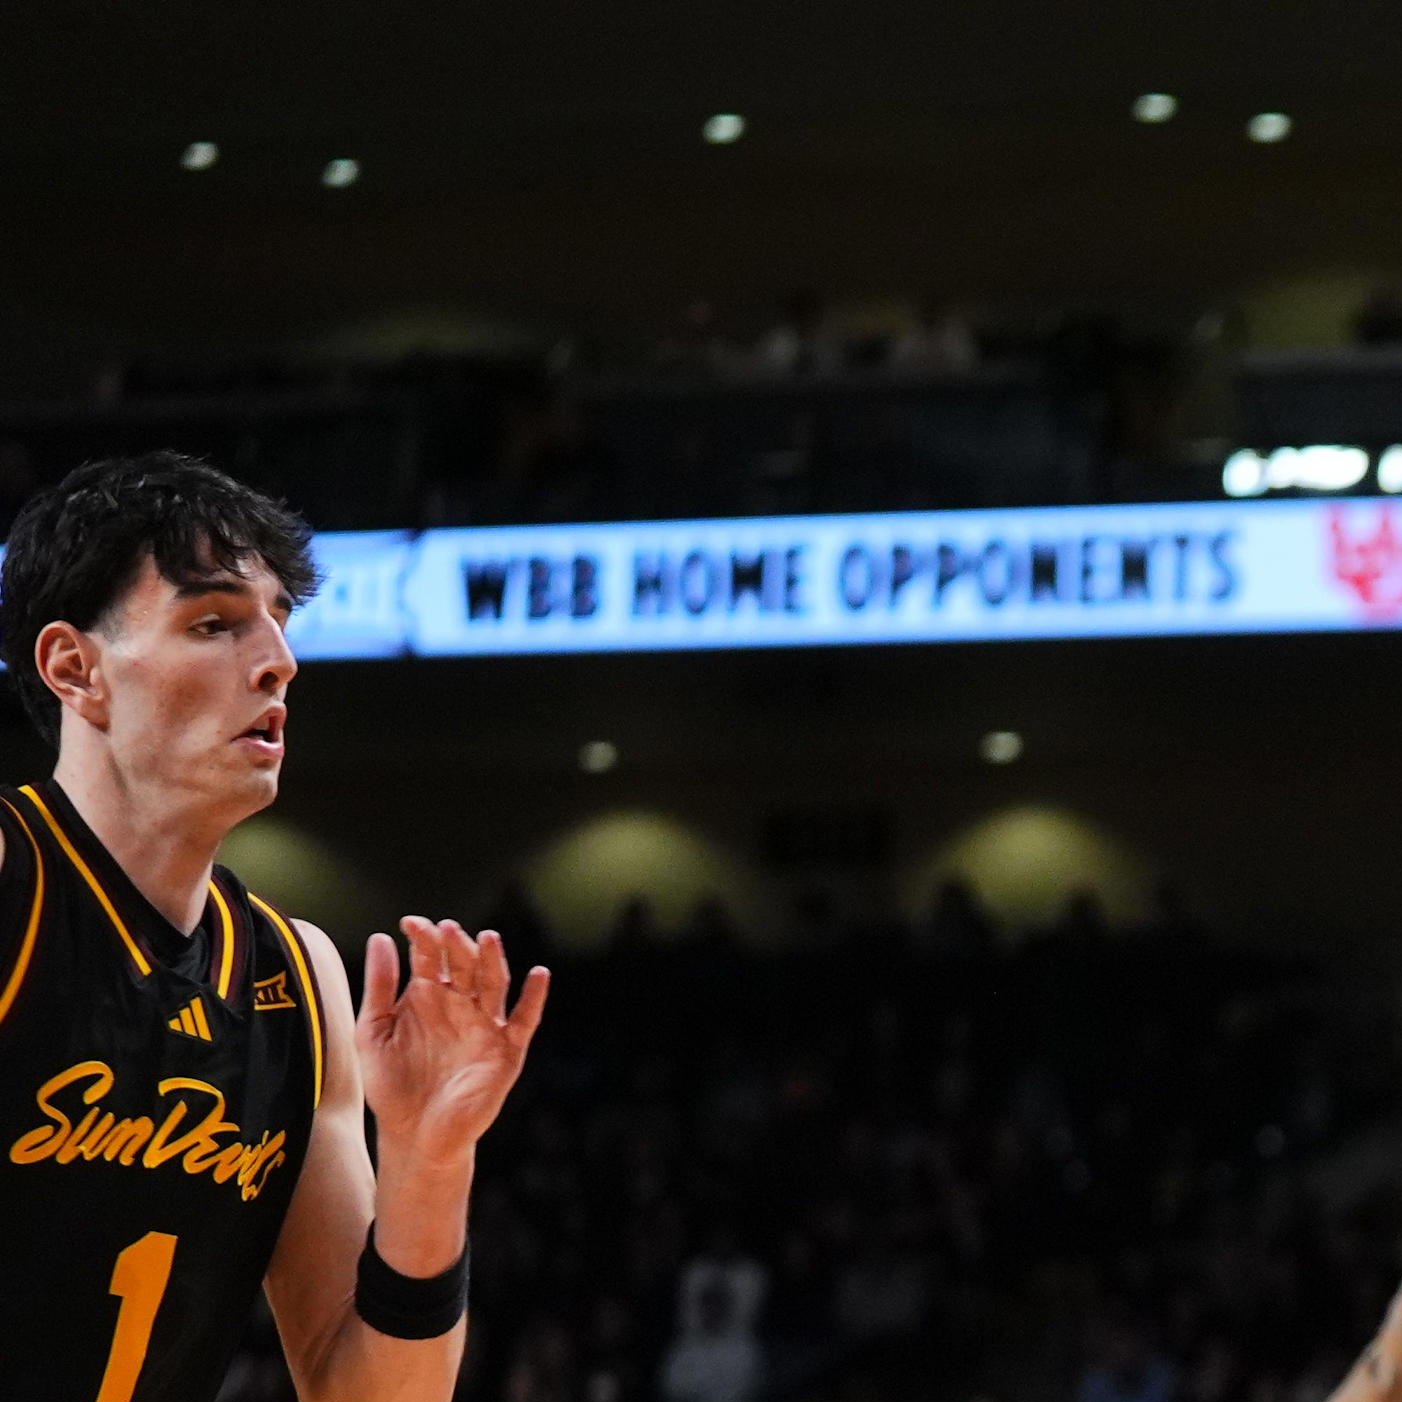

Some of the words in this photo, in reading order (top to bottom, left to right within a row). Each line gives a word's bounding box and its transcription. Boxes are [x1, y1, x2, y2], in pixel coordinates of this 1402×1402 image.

[460, 553, 598, 624] WBB
[632, 545, 805, 617] HOME
[836, 530, 1246, 612] OPPONENTS
